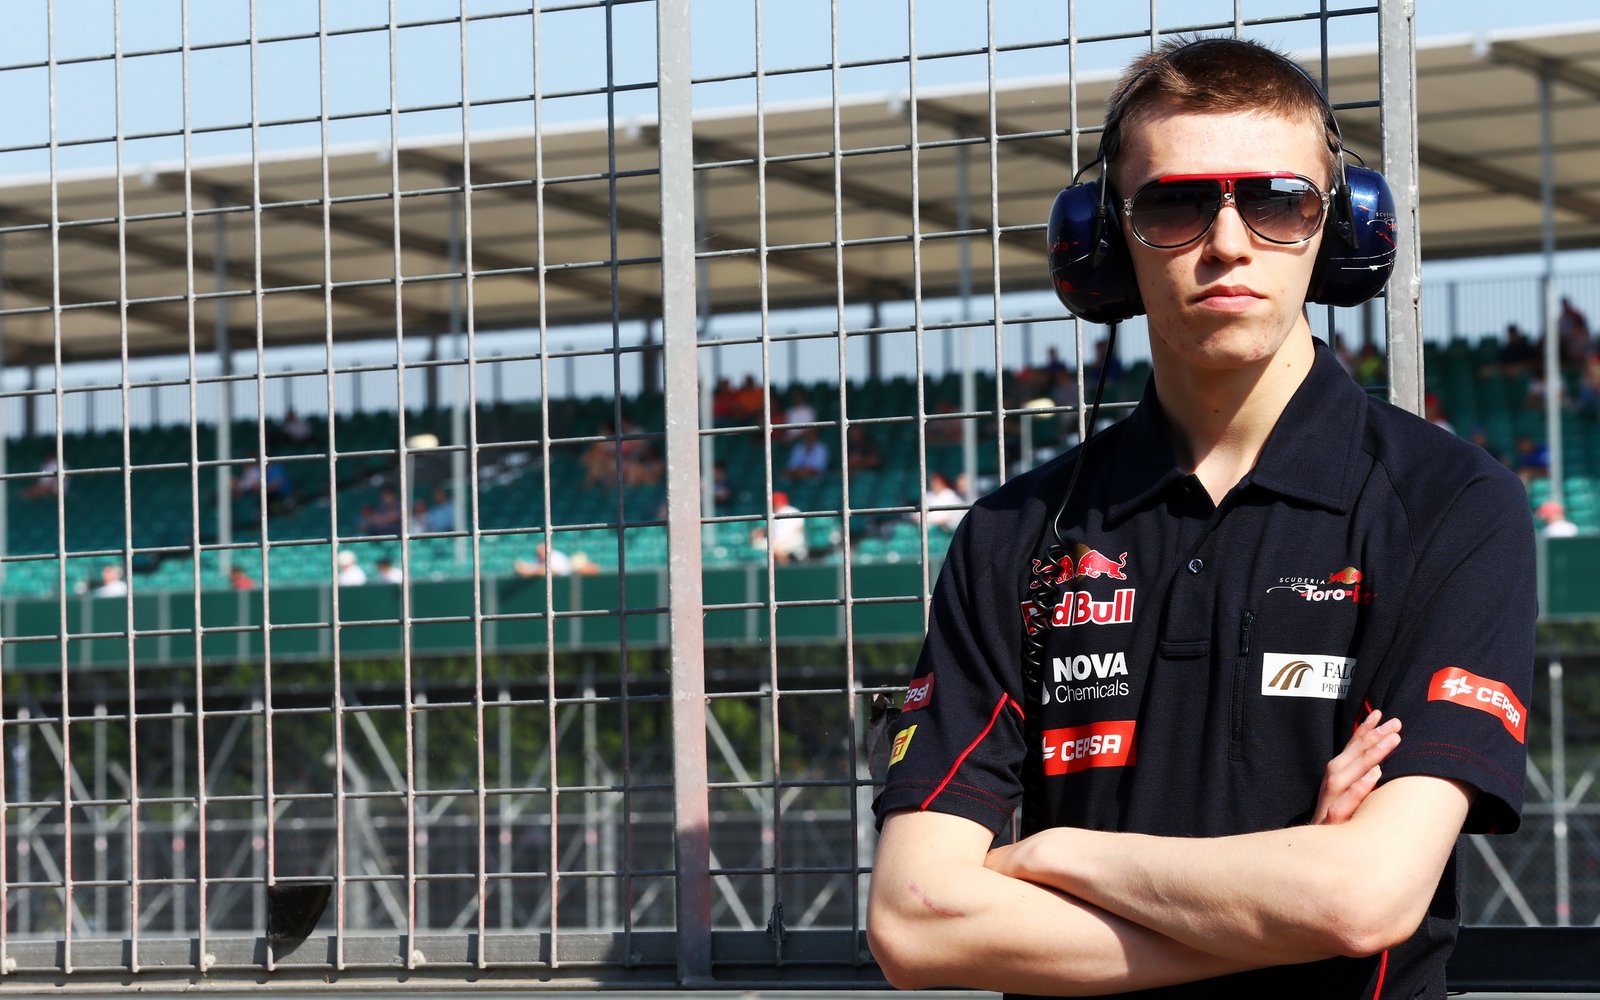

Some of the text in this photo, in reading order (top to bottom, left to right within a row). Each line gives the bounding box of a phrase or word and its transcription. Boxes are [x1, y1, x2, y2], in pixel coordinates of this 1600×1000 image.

[1279, 577, 1326, 585] SCUDERIA
[1305, 584, 1346, 601] Toro
[1021, 591, 1074, 636] Rd
[1052, 651, 1129, 683] NOVA
[1055, 679, 1129, 704] Chemicals
[1476, 686, 1521, 728] CEPSA
[1060, 733, 1123, 762] CEPSA
